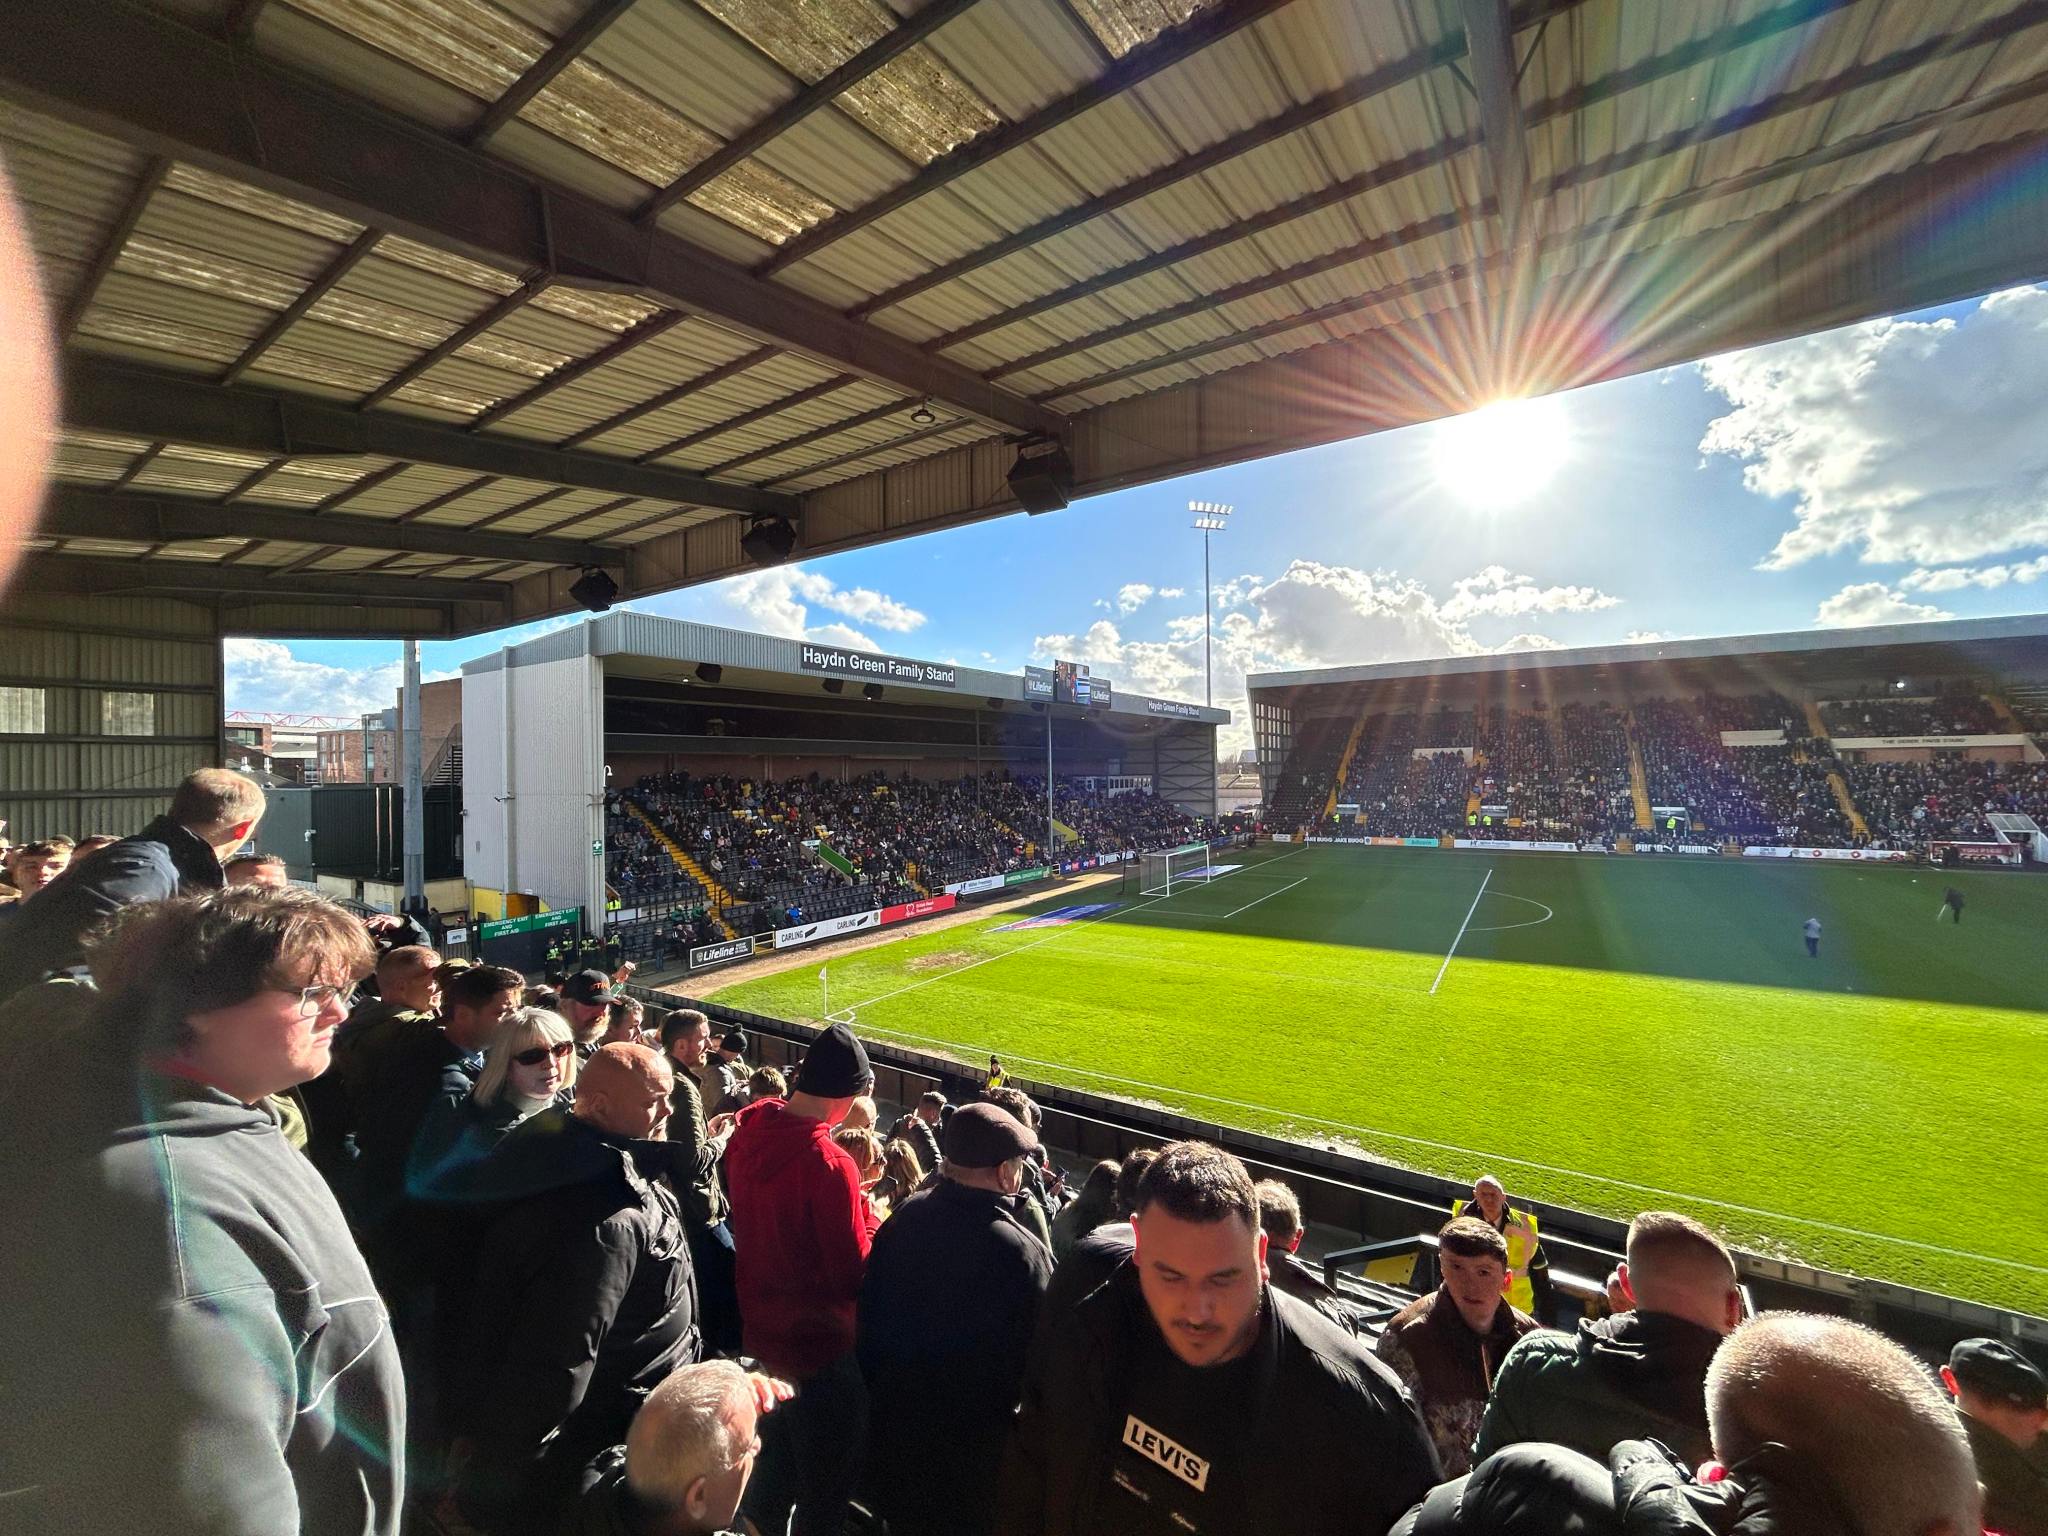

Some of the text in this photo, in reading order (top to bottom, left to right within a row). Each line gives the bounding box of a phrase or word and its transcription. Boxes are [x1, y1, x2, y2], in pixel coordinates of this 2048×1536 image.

[803, 646, 955, 683] Haydn Green Family Stand
[1032, 680, 1052, 693] Lifeline
[1148, 700, 1200, 716] Haydn Green Family Stand
[1678, 845, 1708, 853] PUMA
[535, 910, 565, 919] EMERGENCY
[484, 918, 516, 928] EMERGENCY
[544, 920, 559, 928] FIRST
[837, 918, 857, 930] CARLING
[494, 929, 509, 937] FIRST
[781, 930, 804, 943] CARLING
[703, 946, 735, 961] Lifeline
[1130, 1424, 1201, 1481] LEVI'S
